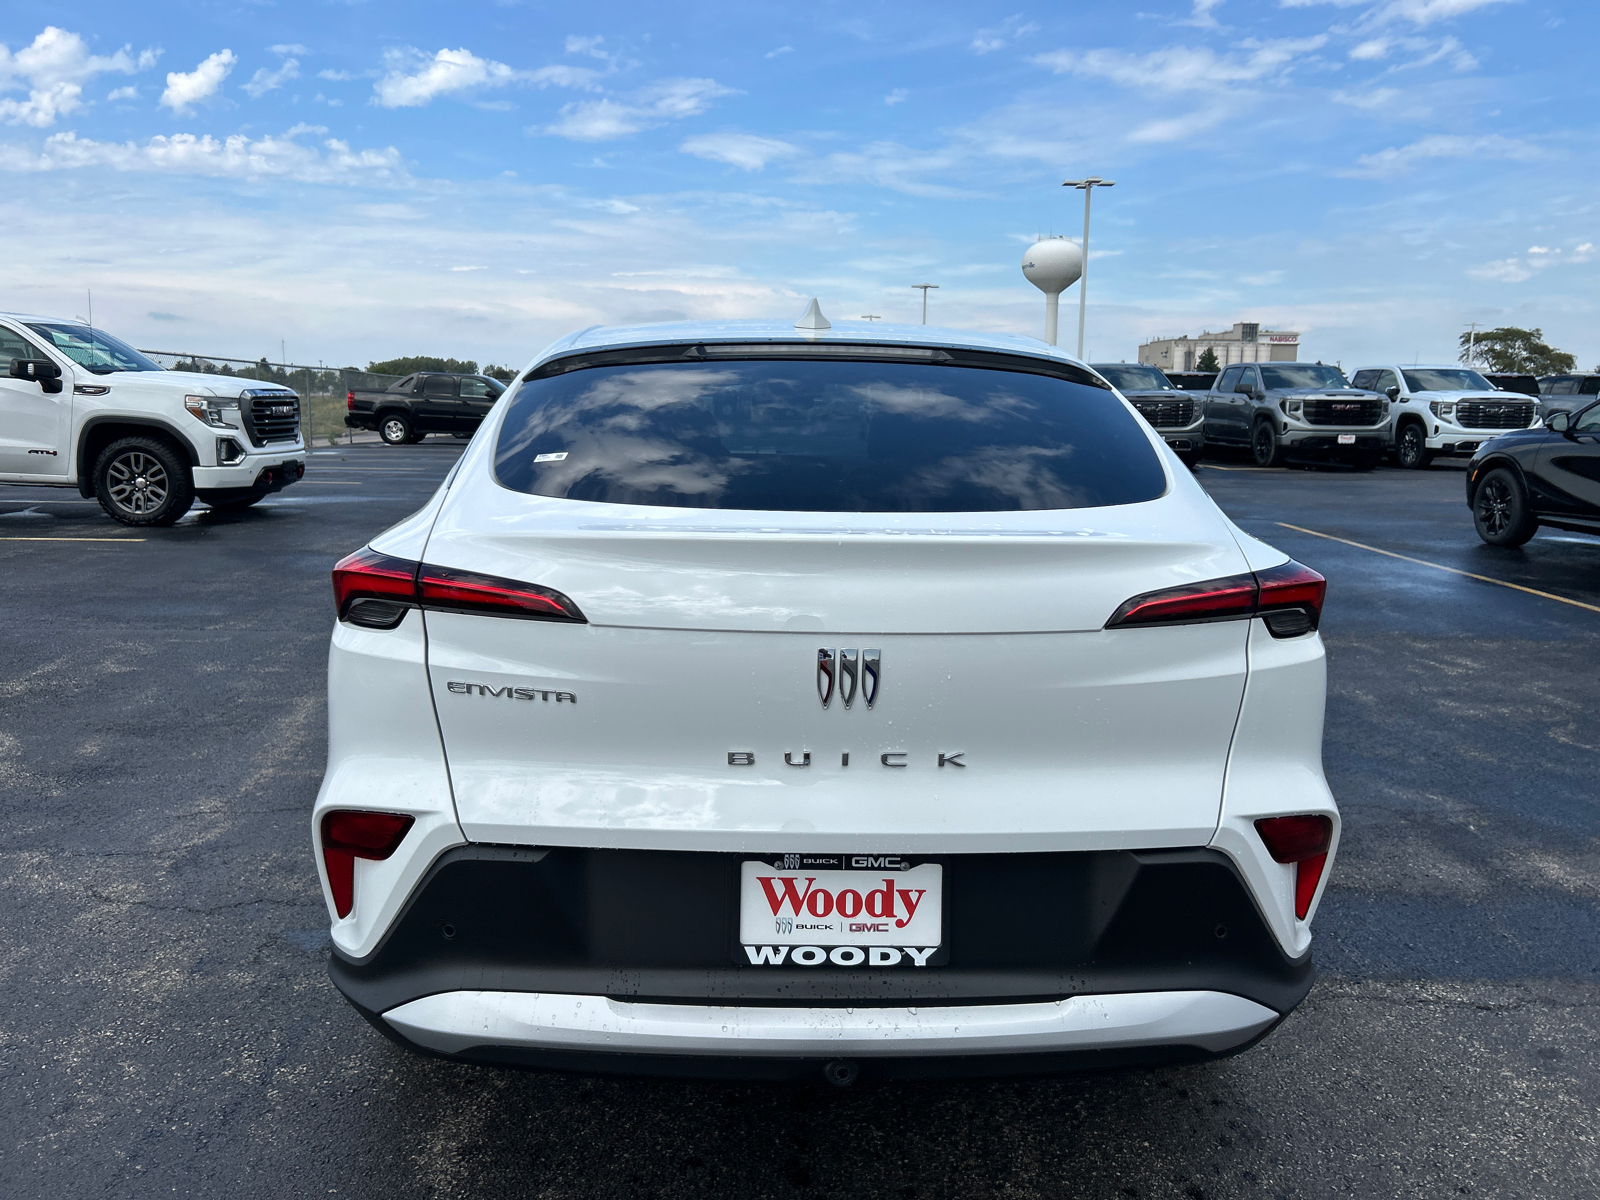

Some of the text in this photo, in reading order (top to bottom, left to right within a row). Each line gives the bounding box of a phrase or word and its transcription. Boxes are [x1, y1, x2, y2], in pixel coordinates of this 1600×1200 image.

[1331, 403, 1361, 411] GMC
[447, 680, 578, 704] ENVISTA
[727, 751, 967, 767] BUICK
[851, 856, 902, 868] GMC
[756, 876, 927, 928] Woody
[849, 923, 889, 932] GMC
[743, 946, 938, 966] WOODY
